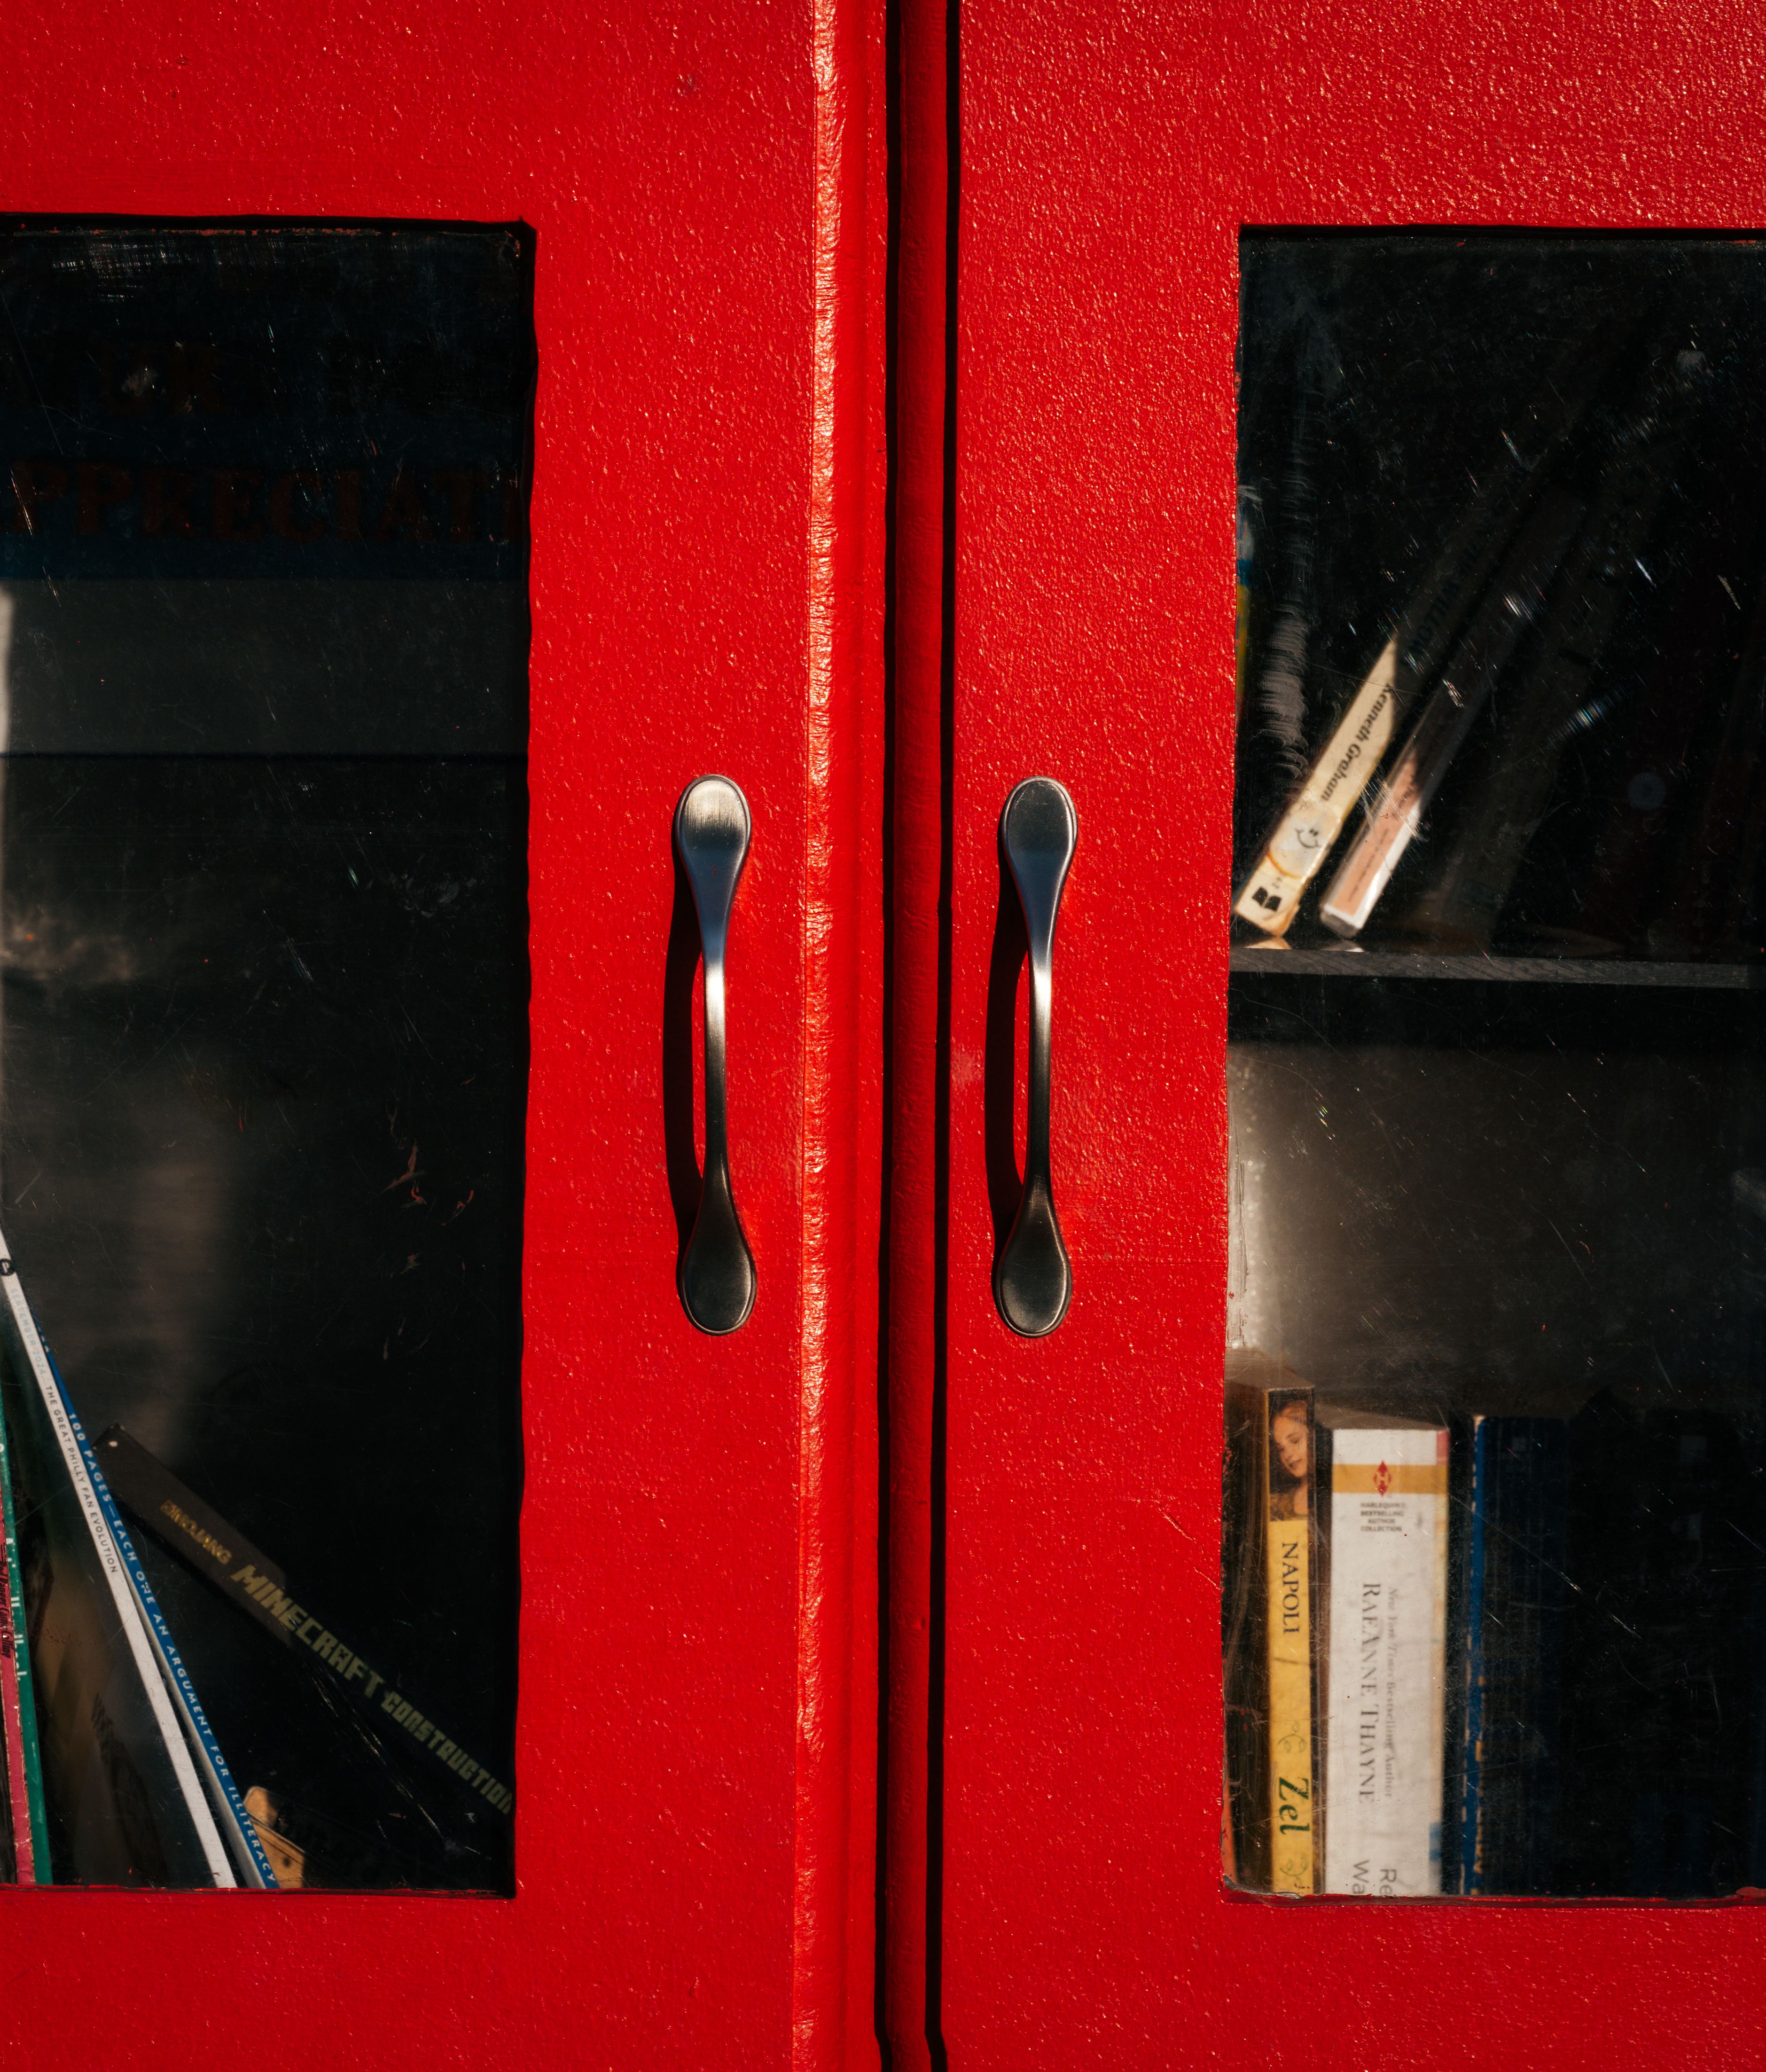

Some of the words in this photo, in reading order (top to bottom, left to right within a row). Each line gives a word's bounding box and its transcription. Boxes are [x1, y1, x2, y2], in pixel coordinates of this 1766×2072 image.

[0, 457, 523, 544] PPRECIAT
[1355, 682, 1395, 743] Kenneth
[45, 1385, 57, 1405] THE
[53, 1408, 72, 1444] GREAT
[66, 1446, 86, 1484] PHILLY
[81, 1486, 94, 1509] FAN
[88, 1510, 119, 1574] EVOLUTION
[1282, 1542, 1300, 1634] NAPOLI
[1387, 1587, 1398, 1611] New
[69, 1414, 86, 1441] 100
[134, 1570, 156, 1605] ONE
[152, 1611, 169, 1637] AN
[166, 1644, 211, 1737] ARGUMENT
[210, 1745, 229, 1777] FOR
[227, 1785, 276, 1884] ILLITERACY
[1386, 1615, 1397, 1639] York
[1386, 1644, 1397, 1677] Times
[230, 1564, 384, 1699] MINECRAFT
[380, 1691, 513, 1814] CONSTRUCTION
[1382, 1681, 1396, 1749] Bestselling
[1359, 1705, 1380, 1803] THAYNE
[1383, 1754, 1394, 1799] Author
[1278, 1776, 1310, 1835] Zel
